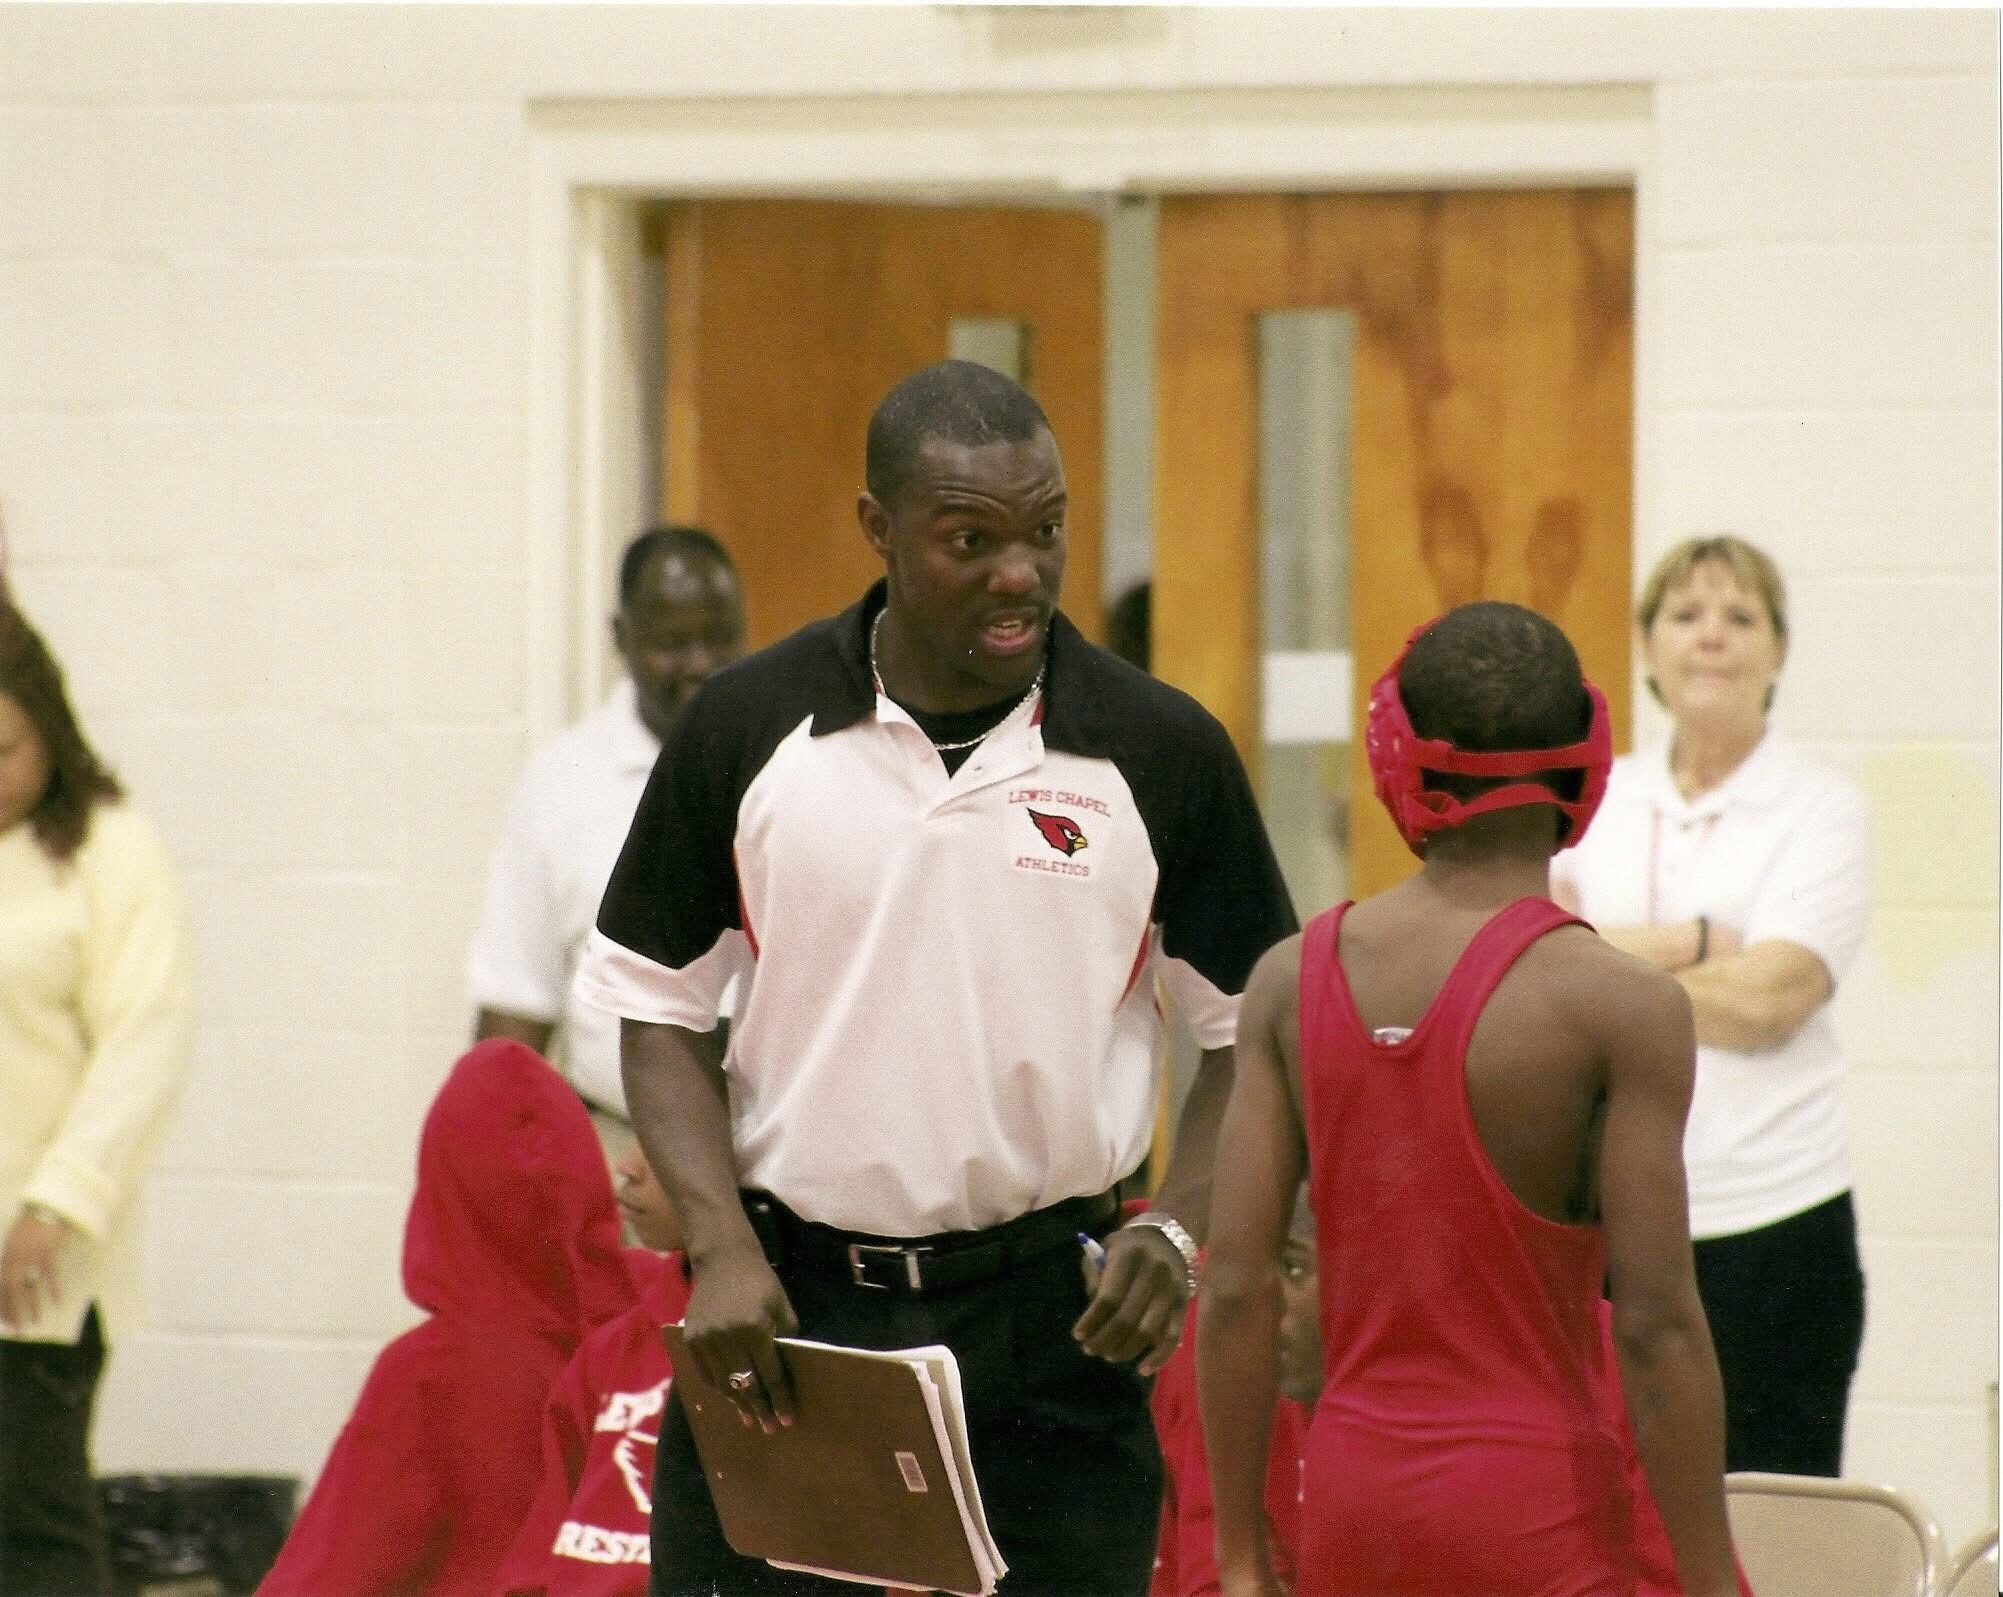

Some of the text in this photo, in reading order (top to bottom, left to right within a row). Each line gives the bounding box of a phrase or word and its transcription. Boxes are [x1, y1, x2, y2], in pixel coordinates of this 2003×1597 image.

[1008, 790, 1111, 817] LEWIS CHAPEL
[1016, 857, 1089, 876] ATHLETICS
